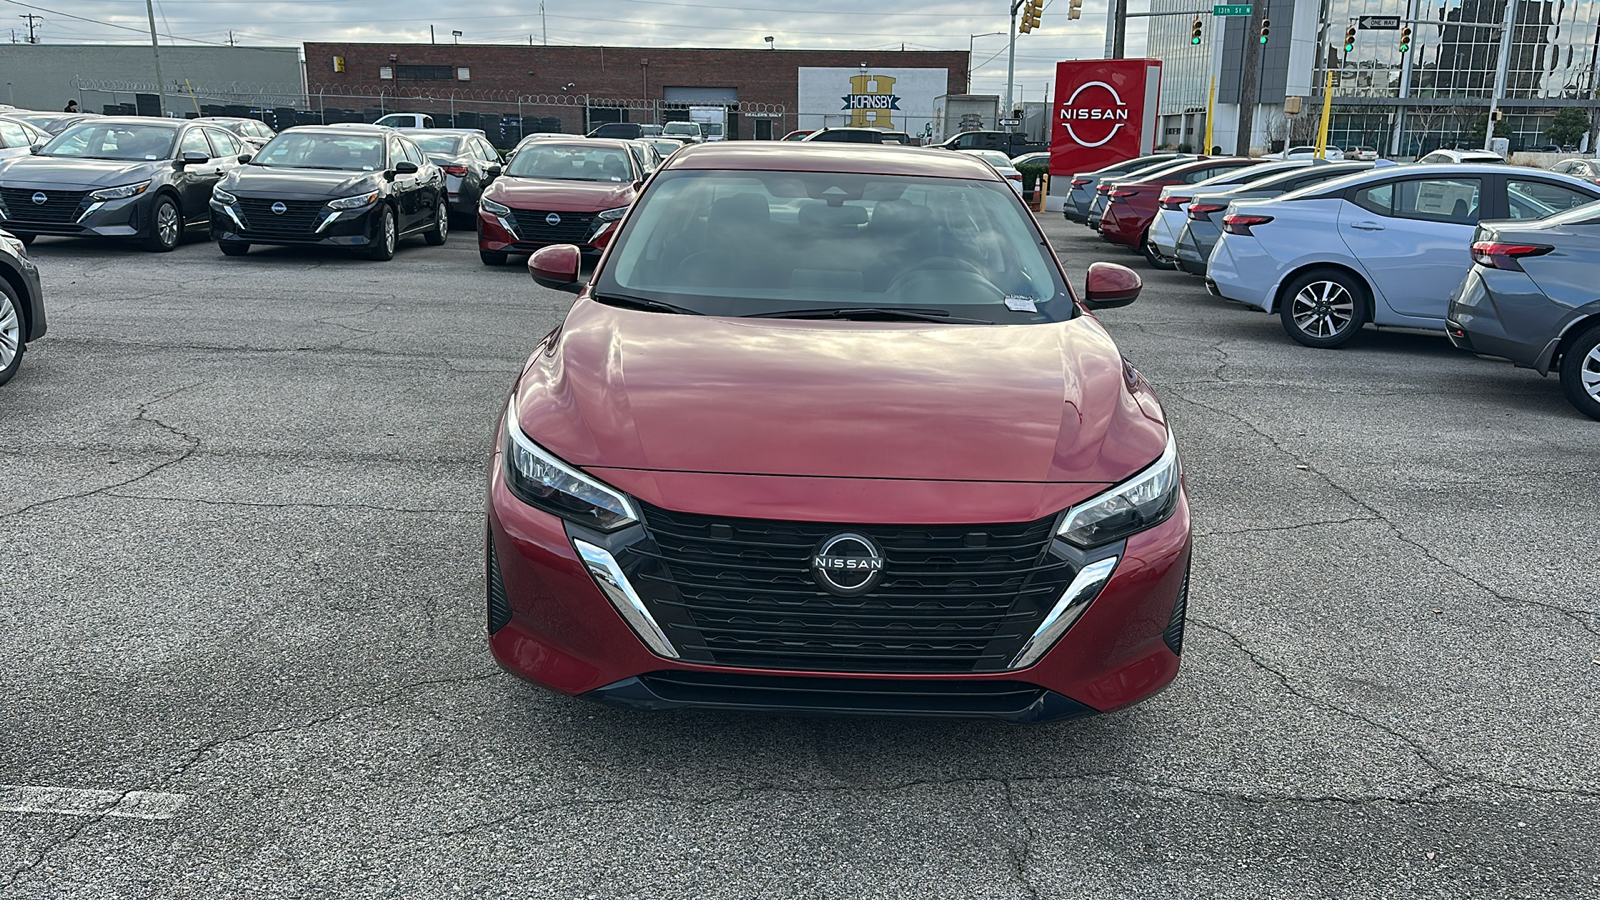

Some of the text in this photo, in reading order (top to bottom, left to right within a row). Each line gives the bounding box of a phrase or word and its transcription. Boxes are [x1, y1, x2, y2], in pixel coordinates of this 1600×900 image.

[850, 95, 894, 109] HORNSBY
[1060, 109, 1128, 120] NISSAN
[815, 556, 882, 569] NISSAN
